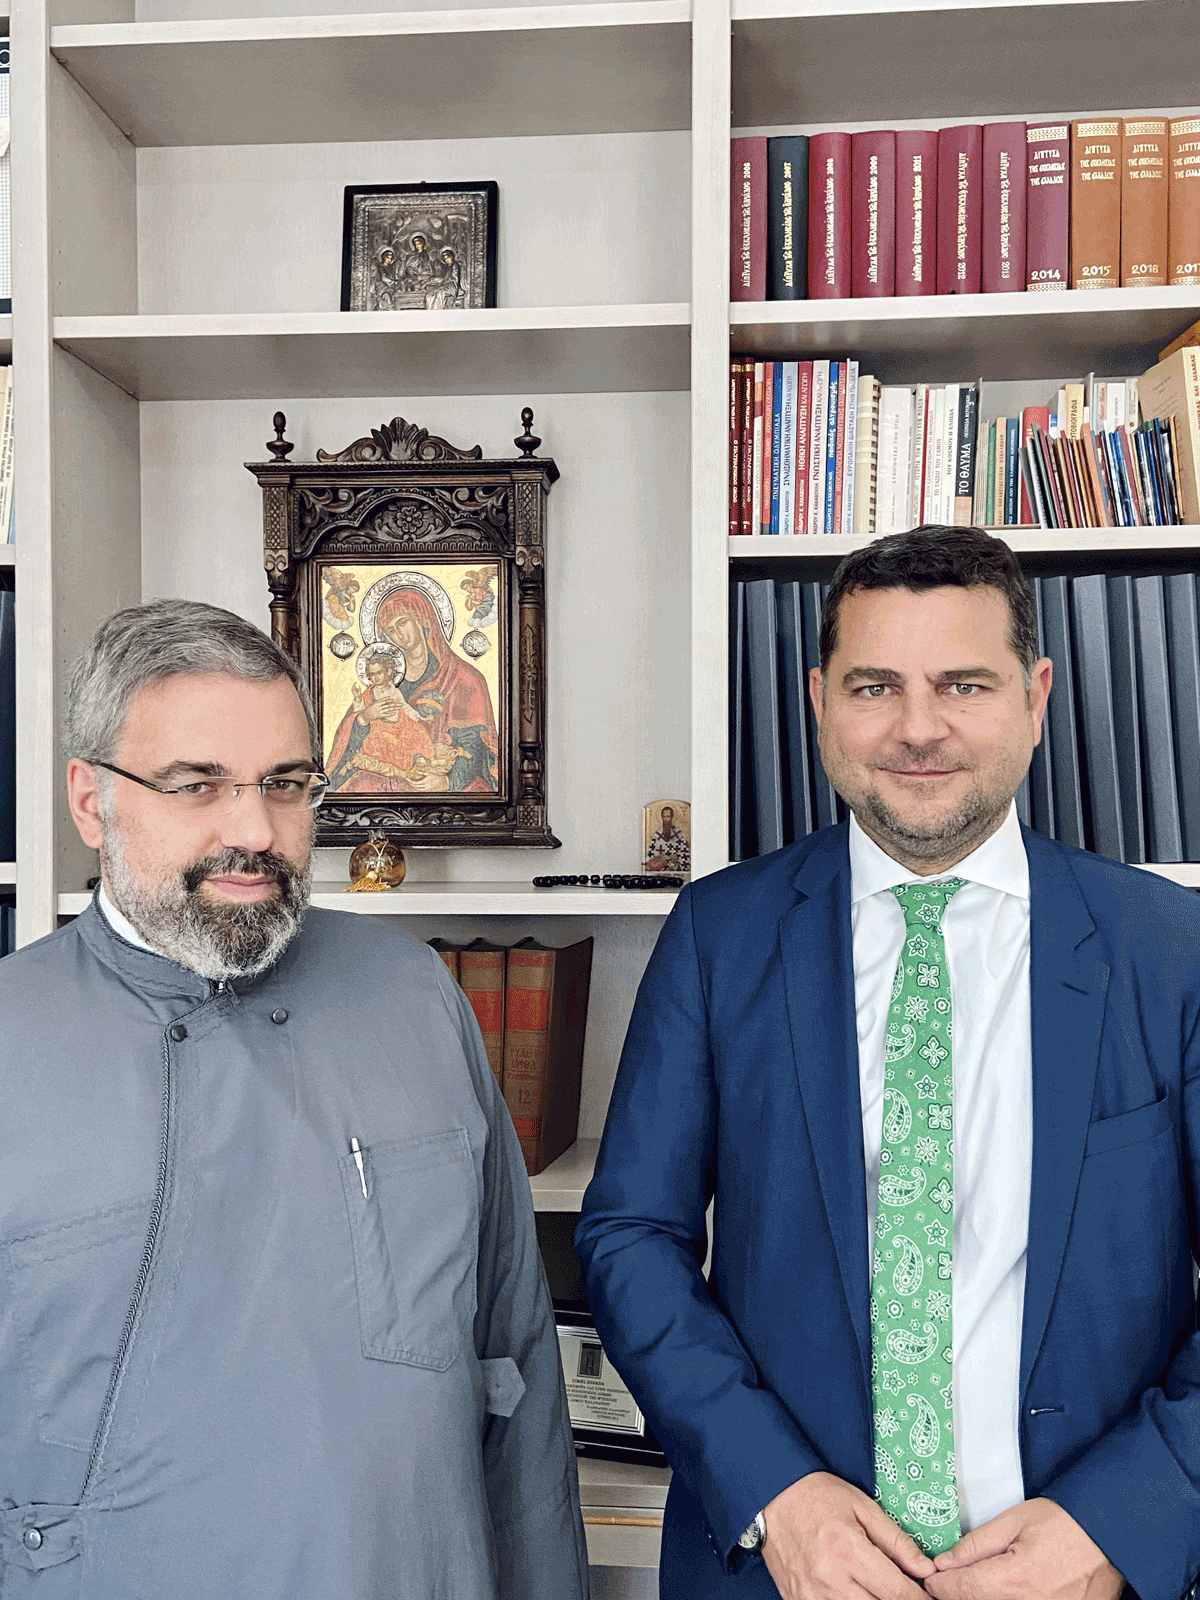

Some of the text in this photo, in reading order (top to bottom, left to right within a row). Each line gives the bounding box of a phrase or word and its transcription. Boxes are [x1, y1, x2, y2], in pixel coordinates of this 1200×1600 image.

[1031, 269, 1060, 280] 2014
[1082, 266, 1111, 276] 2015
[1132, 264, 1158, 274] 2016
[829, 382, 837, 425] αλτρουισμός
[960, 443, 971, 479] ΘΑΥΜΑ
[959, 481, 969, 494] ΤΟ
